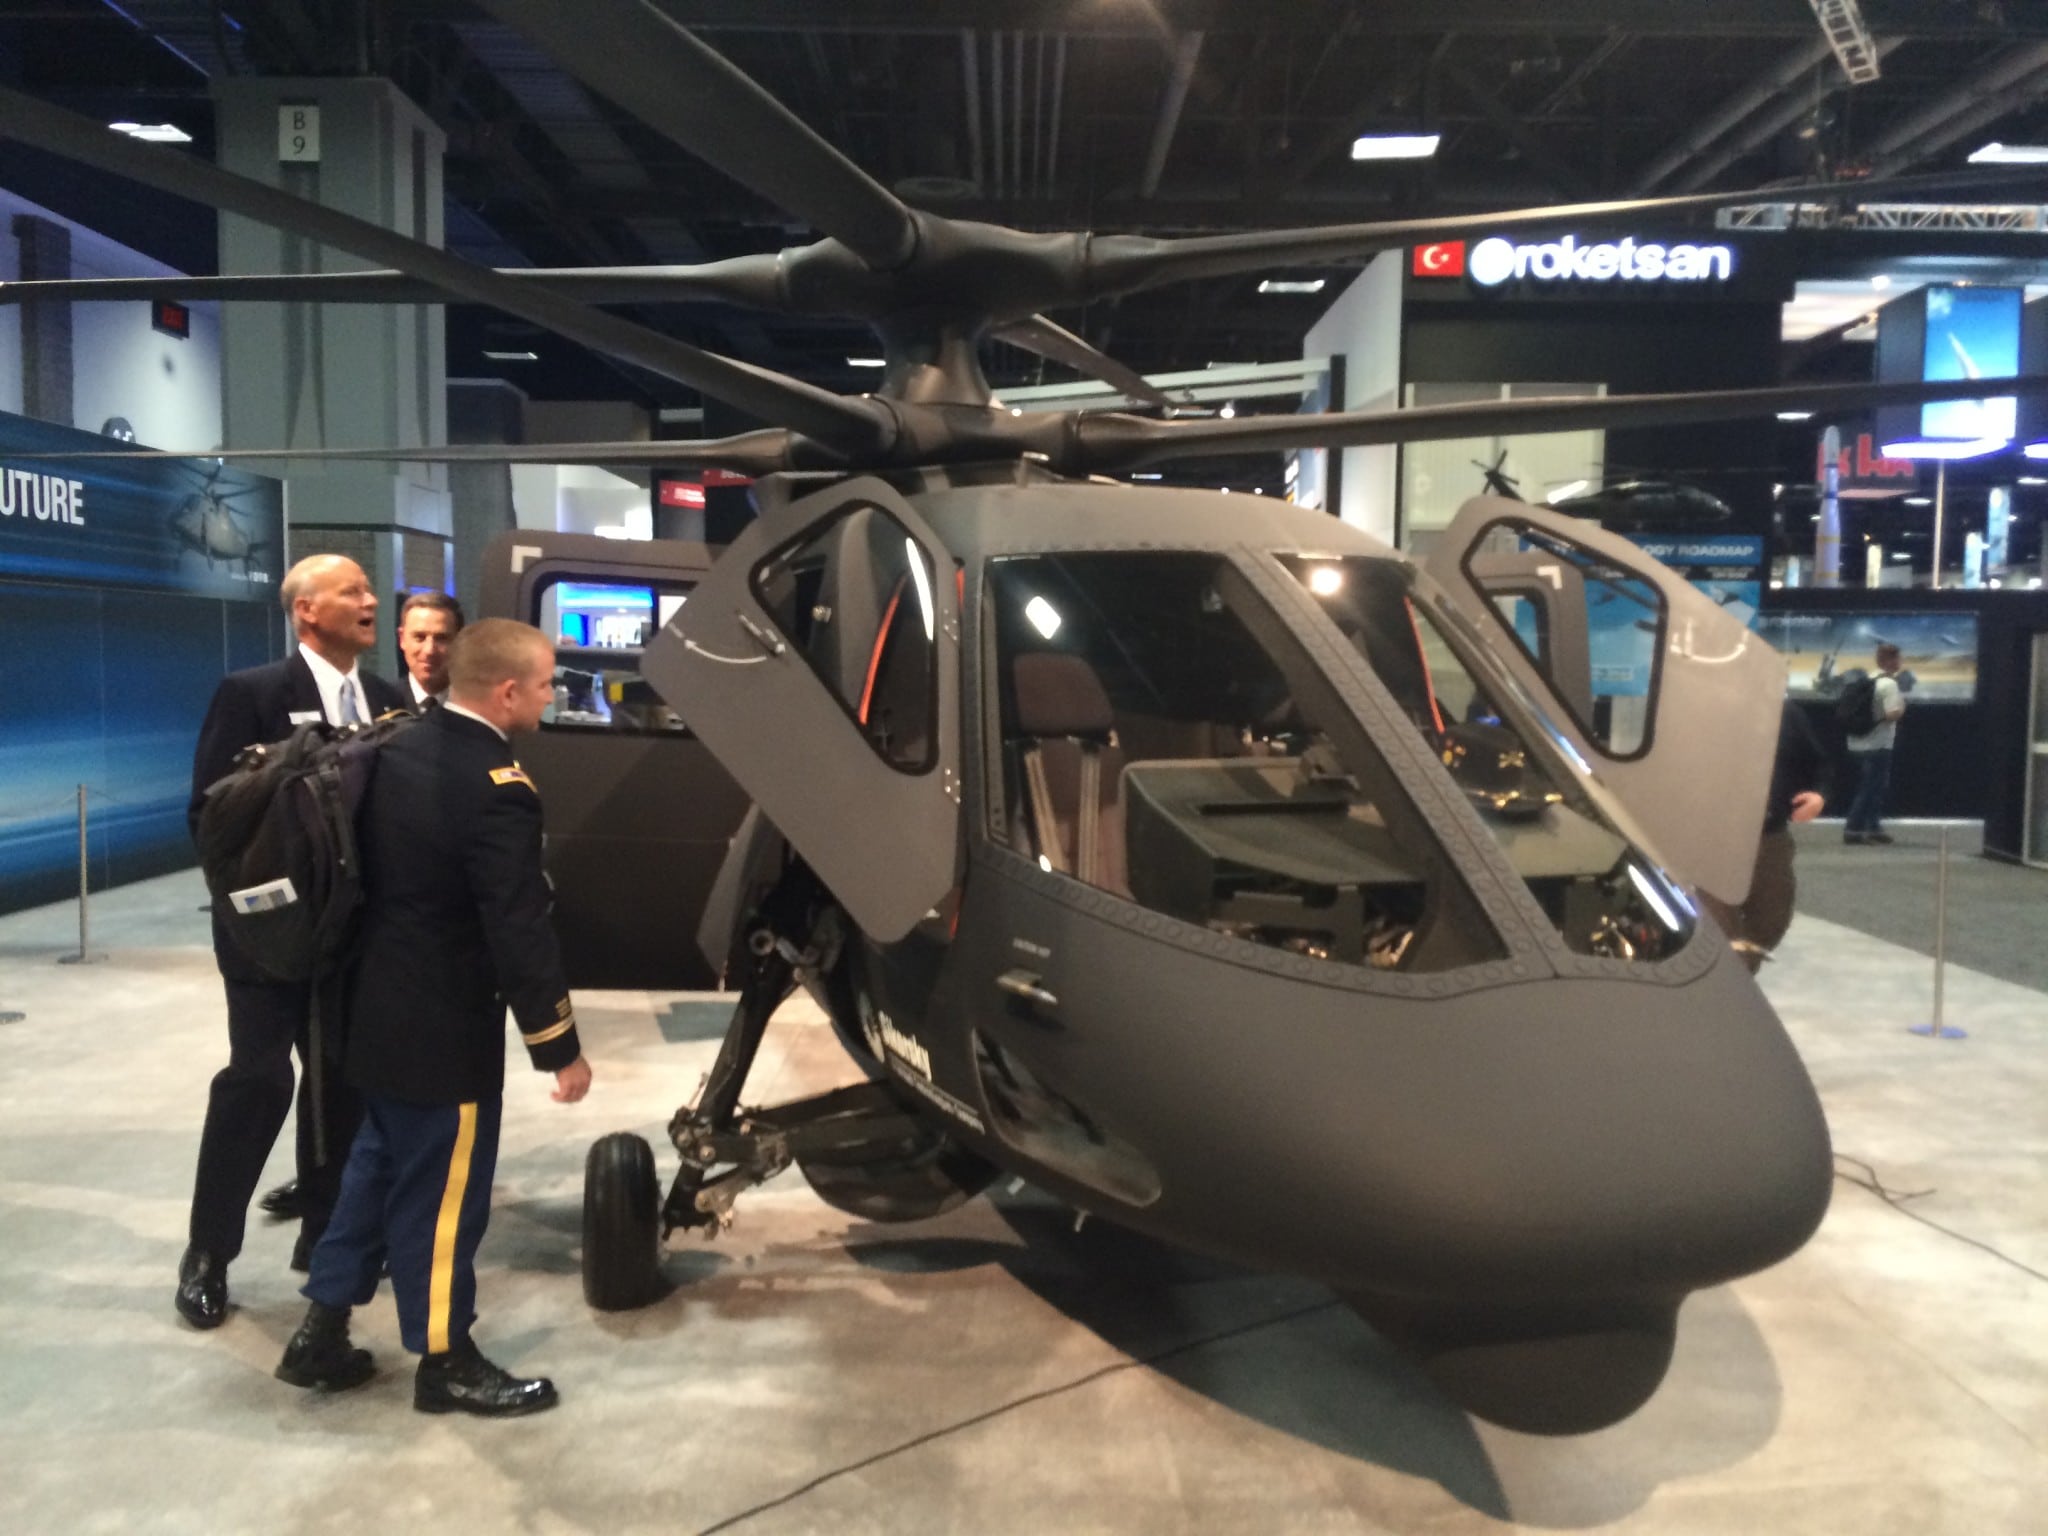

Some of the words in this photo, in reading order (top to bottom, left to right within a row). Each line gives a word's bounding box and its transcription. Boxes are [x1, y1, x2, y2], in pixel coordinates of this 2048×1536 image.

[294, 111, 306, 130] B
[293, 135, 306, 155] 9
[1515, 235, 1731, 280] roketsan
[1679, 544, 1754, 556] ROADMAP
